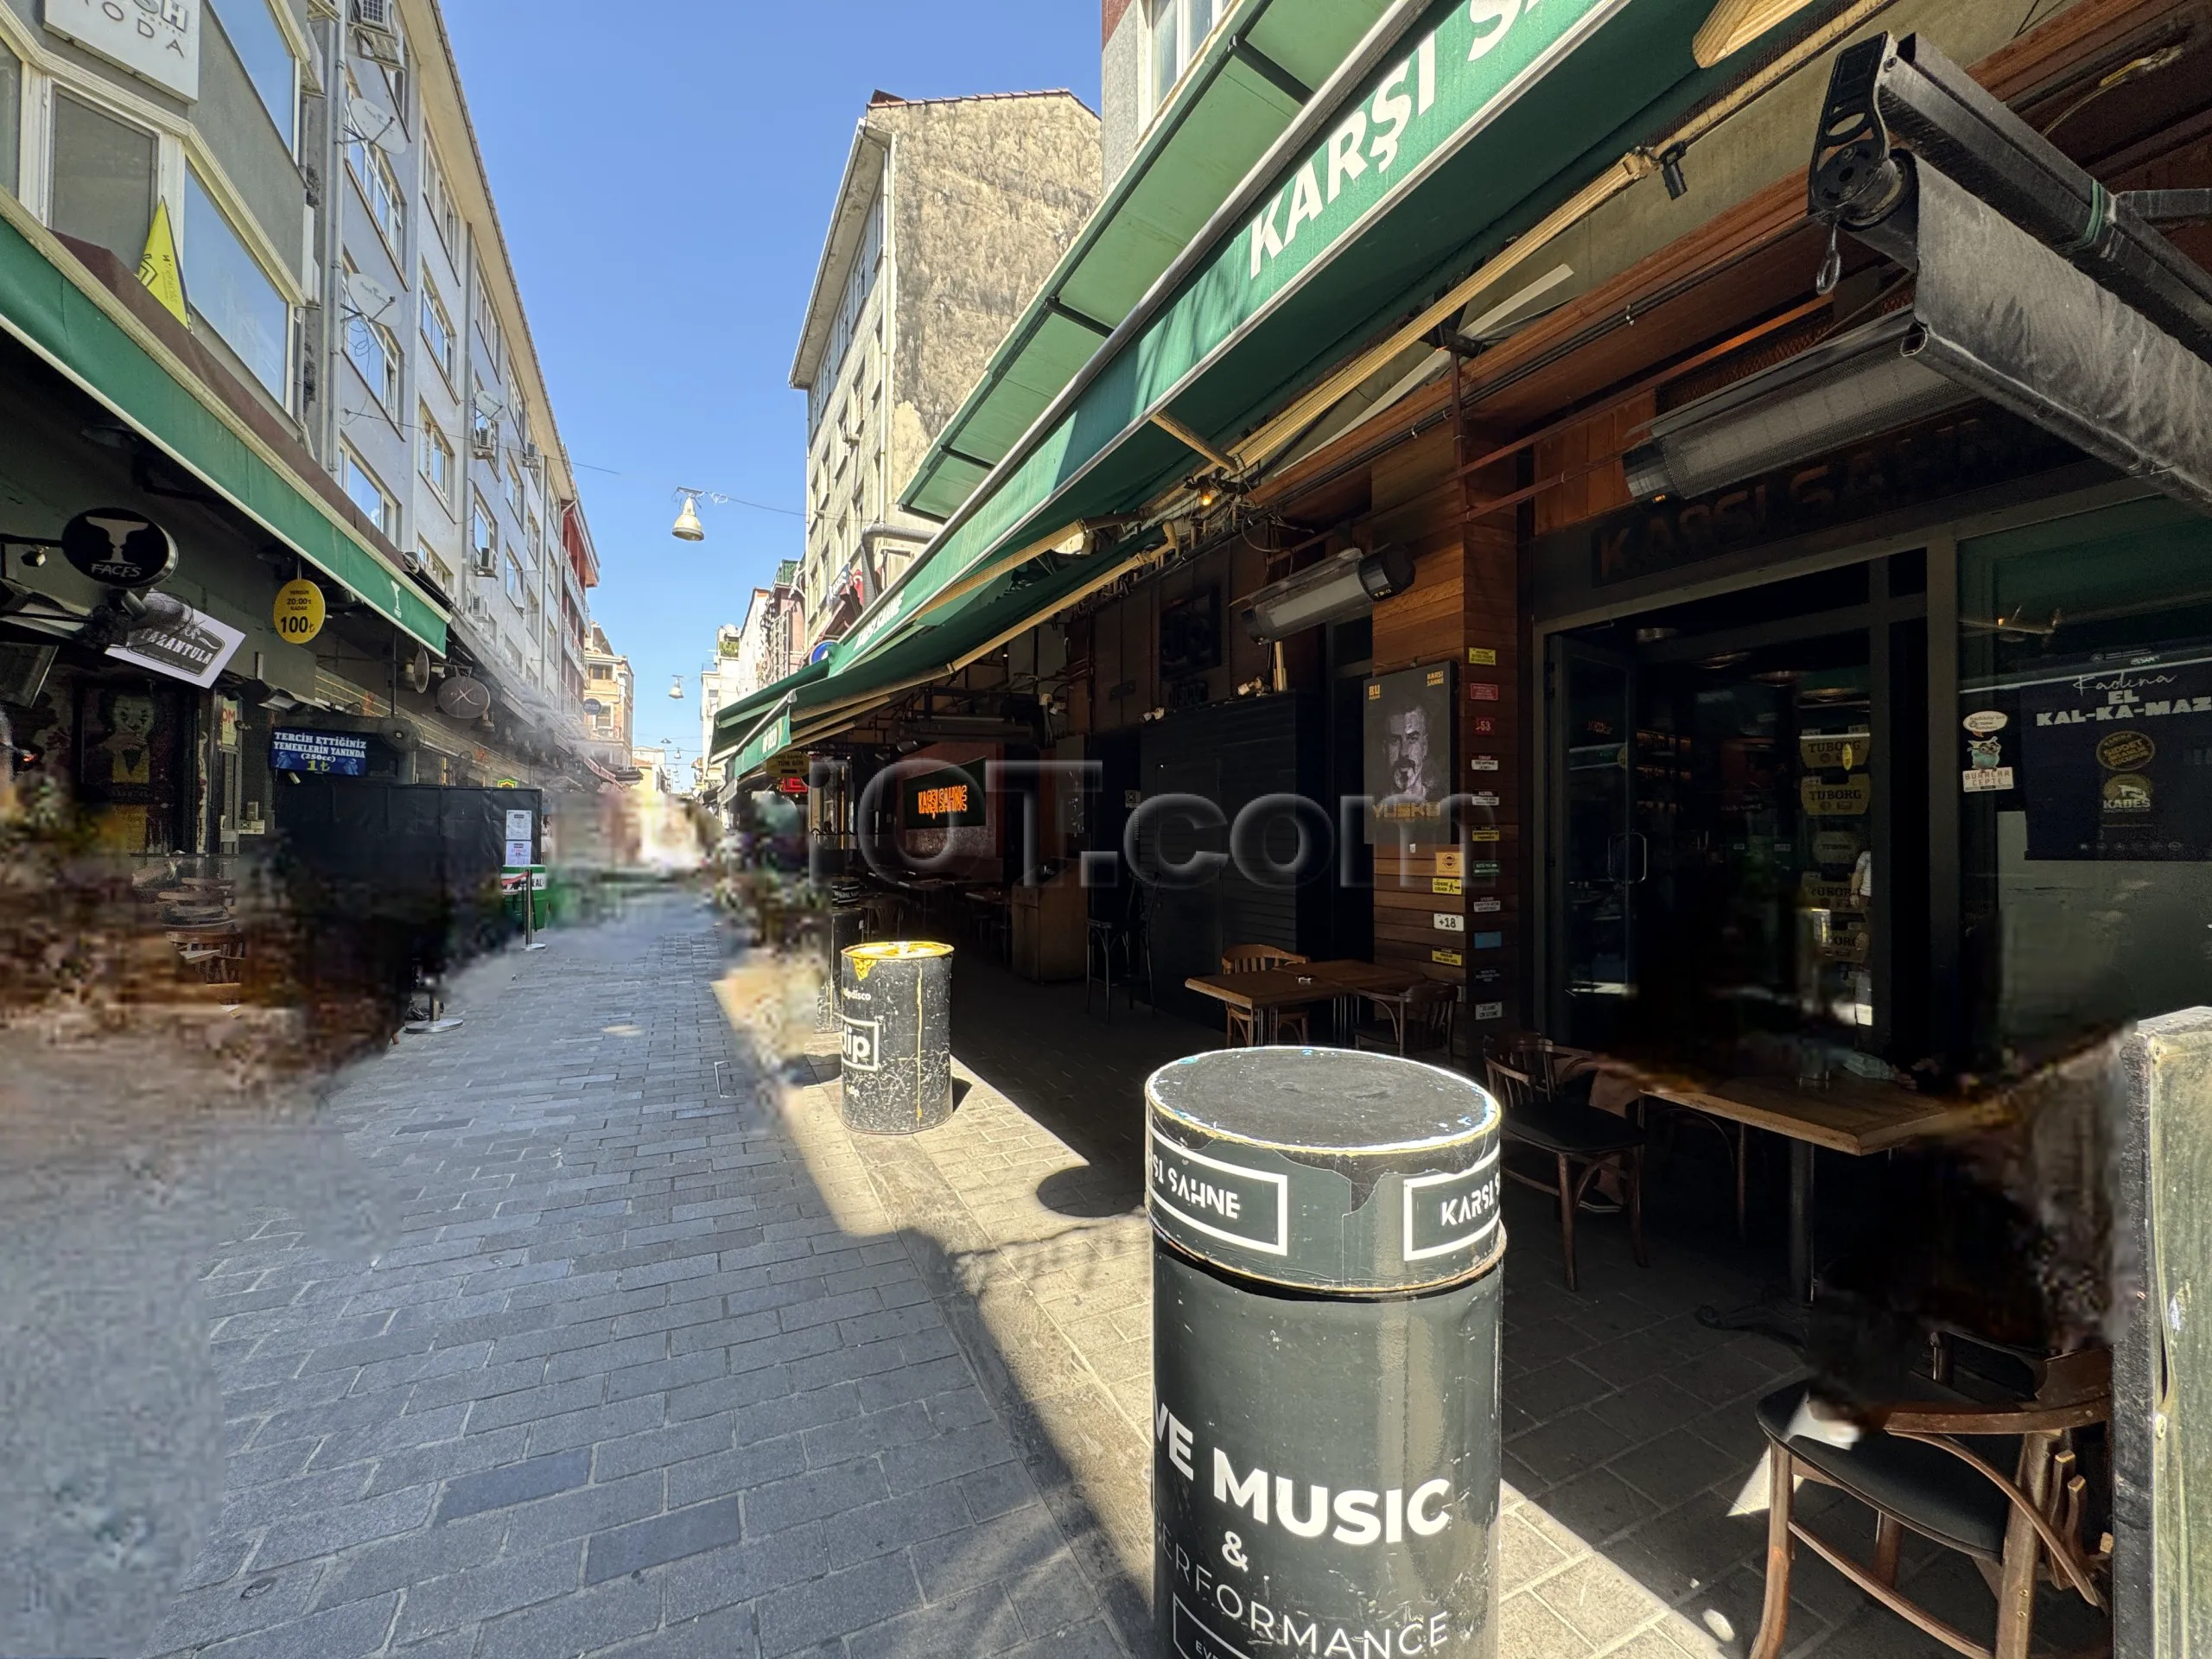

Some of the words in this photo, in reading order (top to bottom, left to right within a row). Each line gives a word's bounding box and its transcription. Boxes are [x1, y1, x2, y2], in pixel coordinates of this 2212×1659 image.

[1250, 30, 1436, 280] KARŞI
[91, 563, 142, 577] FACES
[1369, 683, 1380, 696] BU
[2108, 689, 2140, 704] EL
[274, 732, 312, 743] TERCİH
[273, 741, 328, 754] YEMEKLERİN
[330, 747, 365, 758] YANINDA
[1808, 789, 1861, 800] TUBORG
[1439, 918, 1456, 928] +18
[1167, 1166, 1241, 1219] SAHNE
[1441, 1179, 1494, 1226] KARSI
[1213, 1446, 1450, 1546] MUSIC
[1221, 1530, 1249, 1572] &
